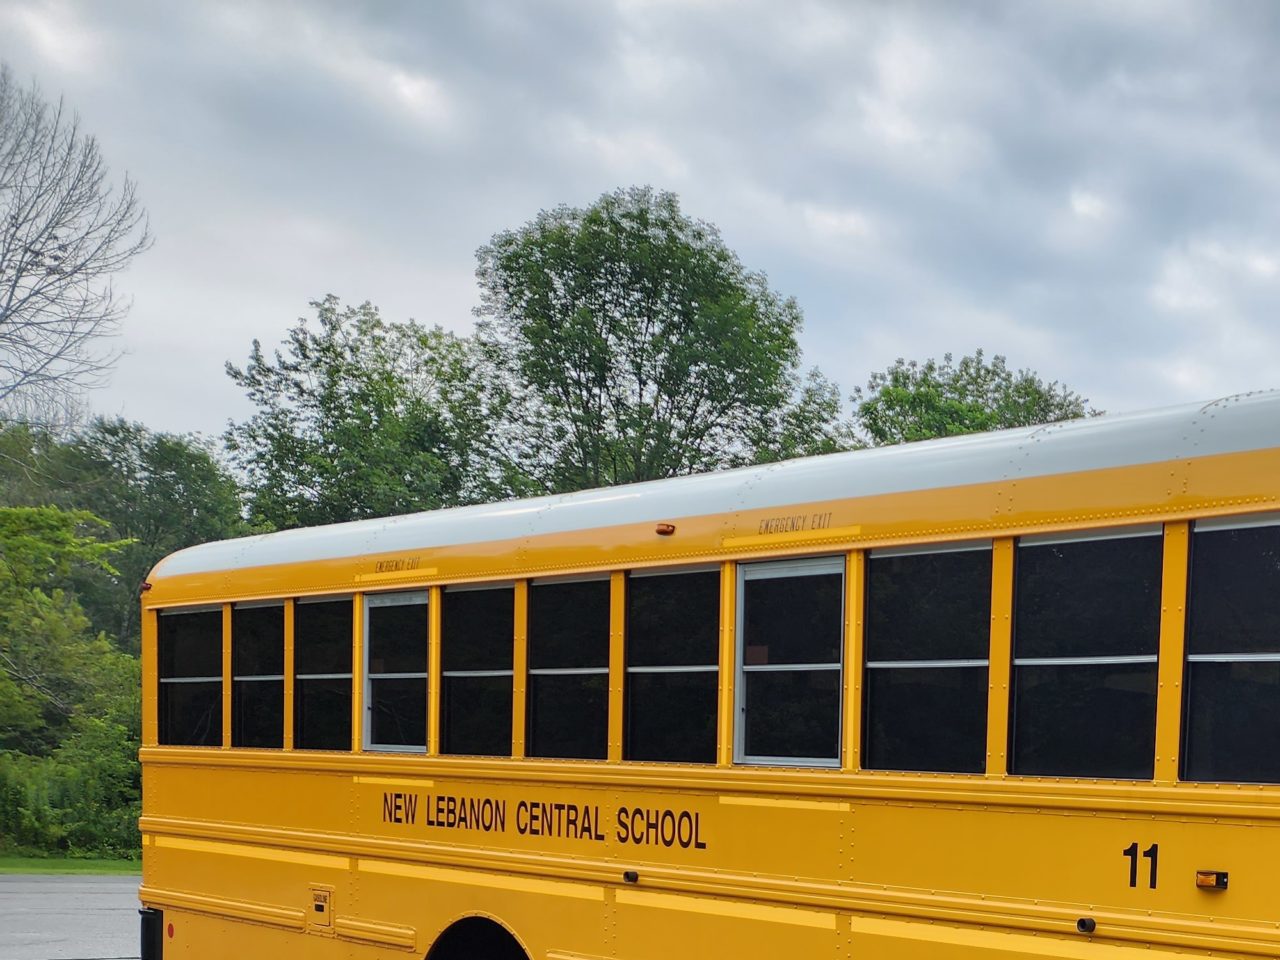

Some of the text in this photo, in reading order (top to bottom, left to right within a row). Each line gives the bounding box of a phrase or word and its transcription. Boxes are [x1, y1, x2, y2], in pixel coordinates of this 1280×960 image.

[759, 513, 832, 534] EMERGENCY EXIT
[382, 791, 707, 850] NEW LEBANON CENTRAL SCHOOL
[1122, 842, 1159, 889] 11
